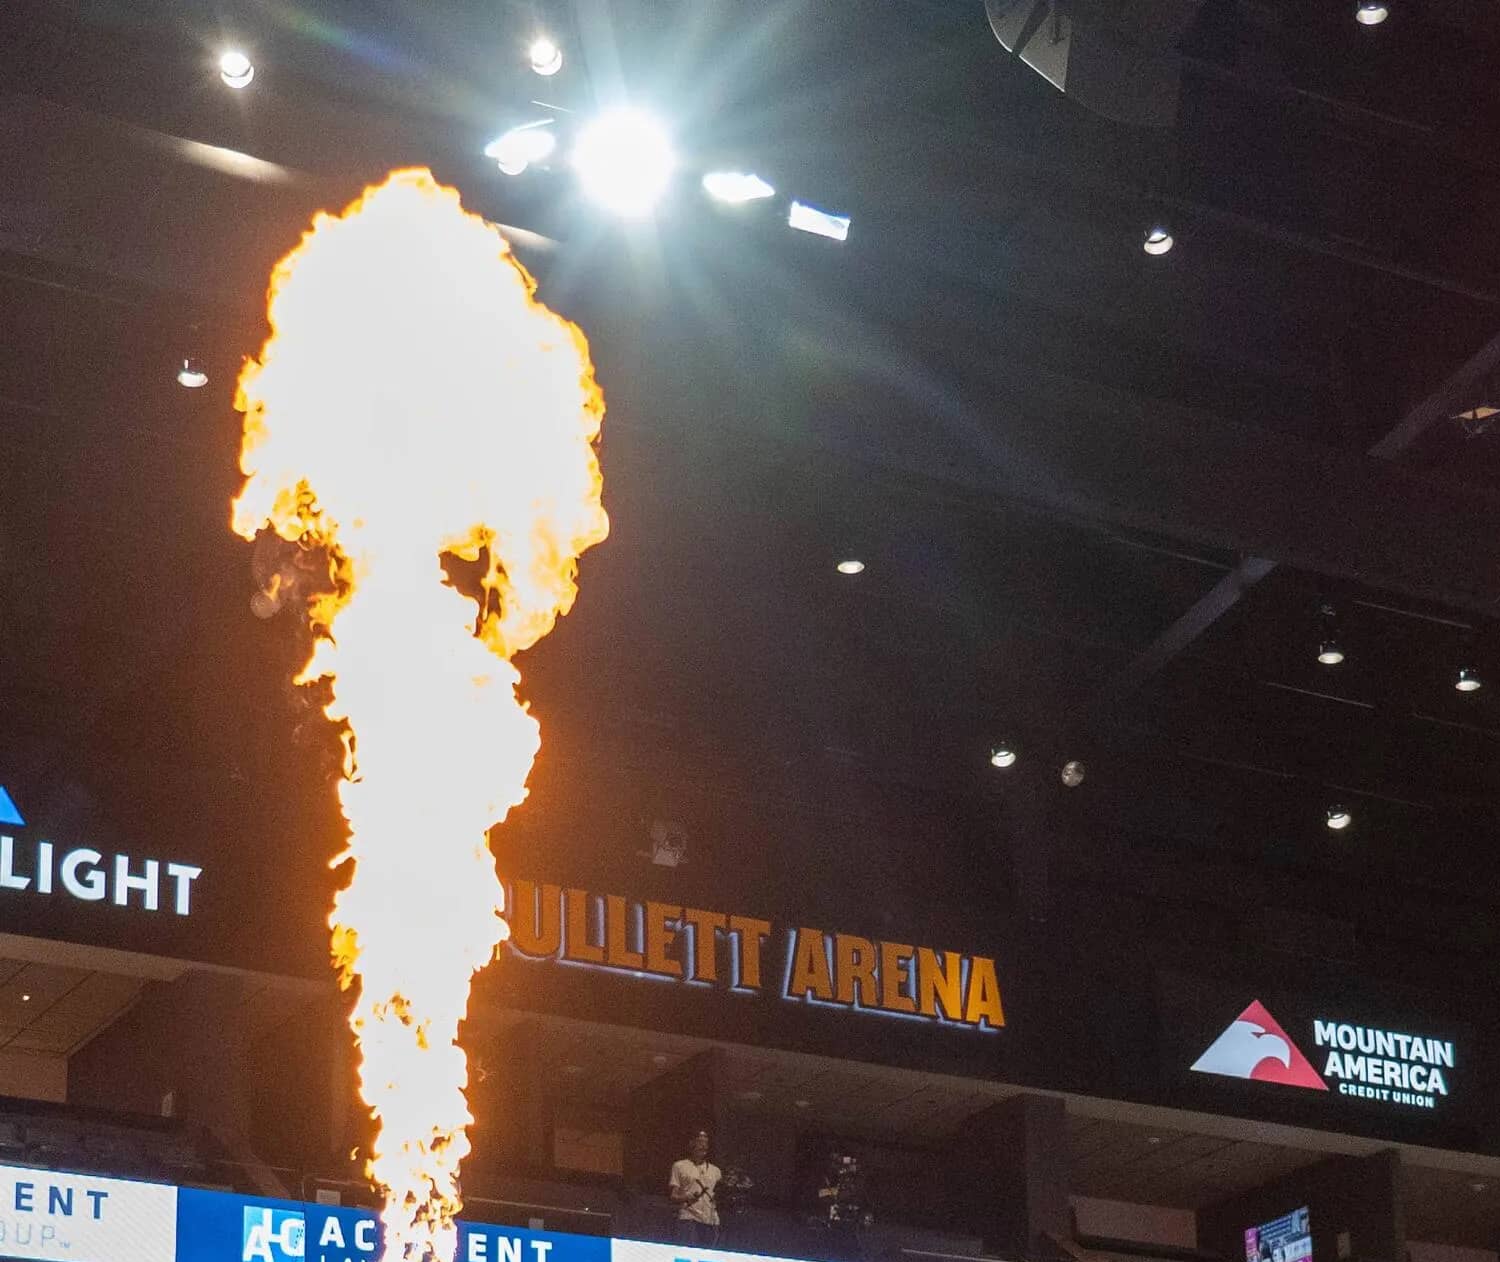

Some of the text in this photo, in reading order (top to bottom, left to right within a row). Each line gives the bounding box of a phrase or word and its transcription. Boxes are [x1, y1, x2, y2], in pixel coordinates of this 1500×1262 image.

[0, 835, 203, 916] LIGHT
[502, 878, 1006, 1031] ULLETT ARENA
[1313, 1019, 1455, 1068] MOUNTAIN
[1323, 1051, 1449, 1096] AMERICA
[1339, 1082, 1435, 1109] CREDIT UNION
